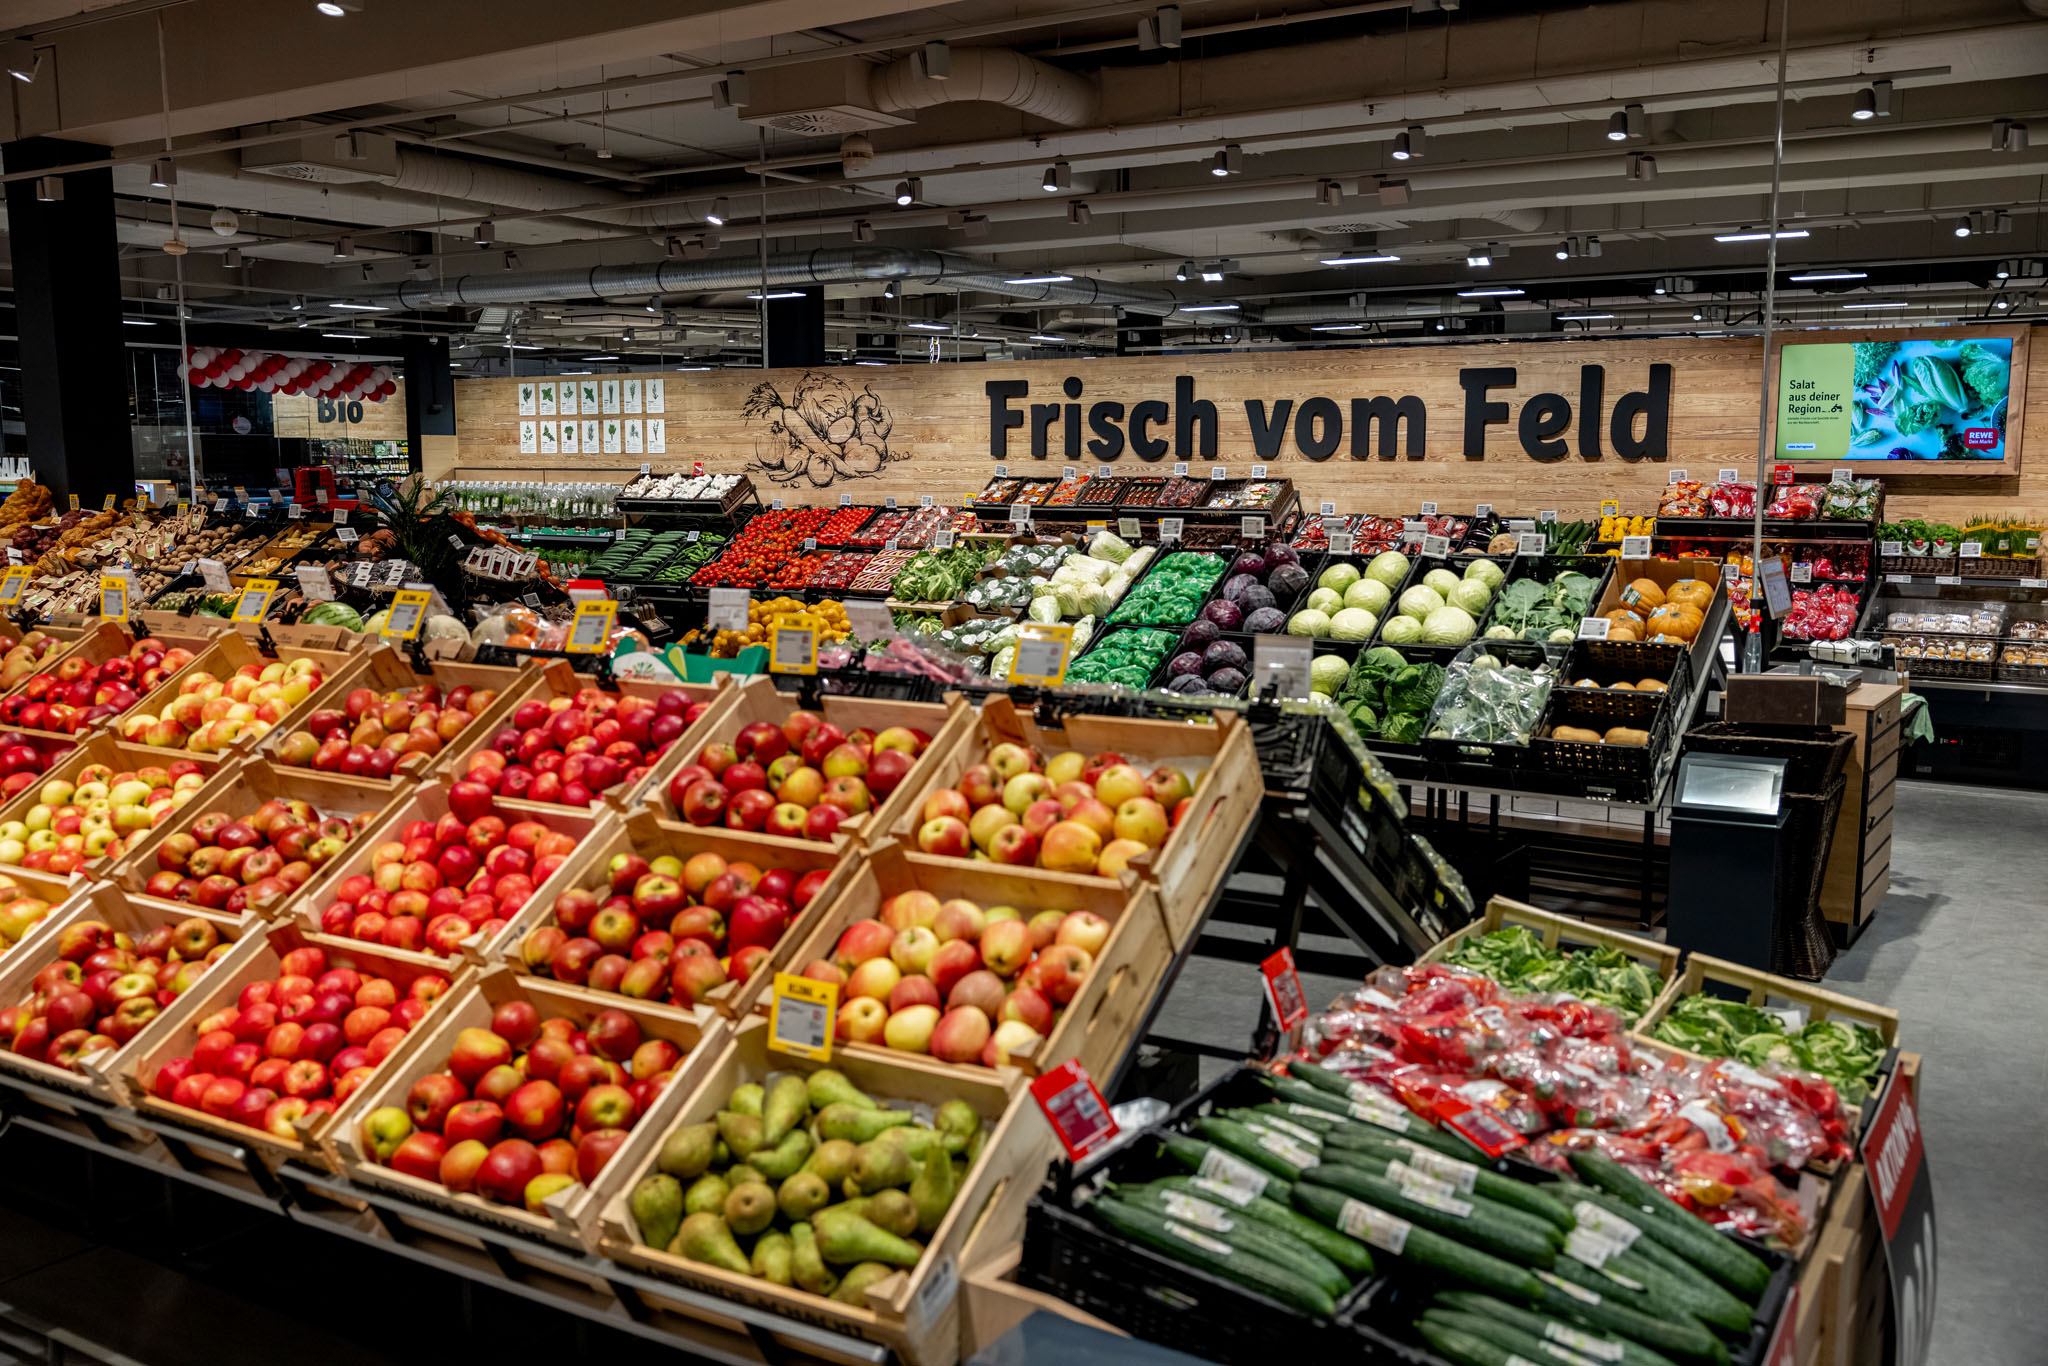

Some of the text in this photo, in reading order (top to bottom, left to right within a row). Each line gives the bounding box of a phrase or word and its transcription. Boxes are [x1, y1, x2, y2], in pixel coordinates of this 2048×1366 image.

[1789, 379, 1816, 390] Salat
[1788, 391, 1841, 402] aus deiner
[317, 393, 364, 424] Bio
[985, 363, 1672, 463] Frisch vom Feld
[1969, 431, 1994, 439] REWE
